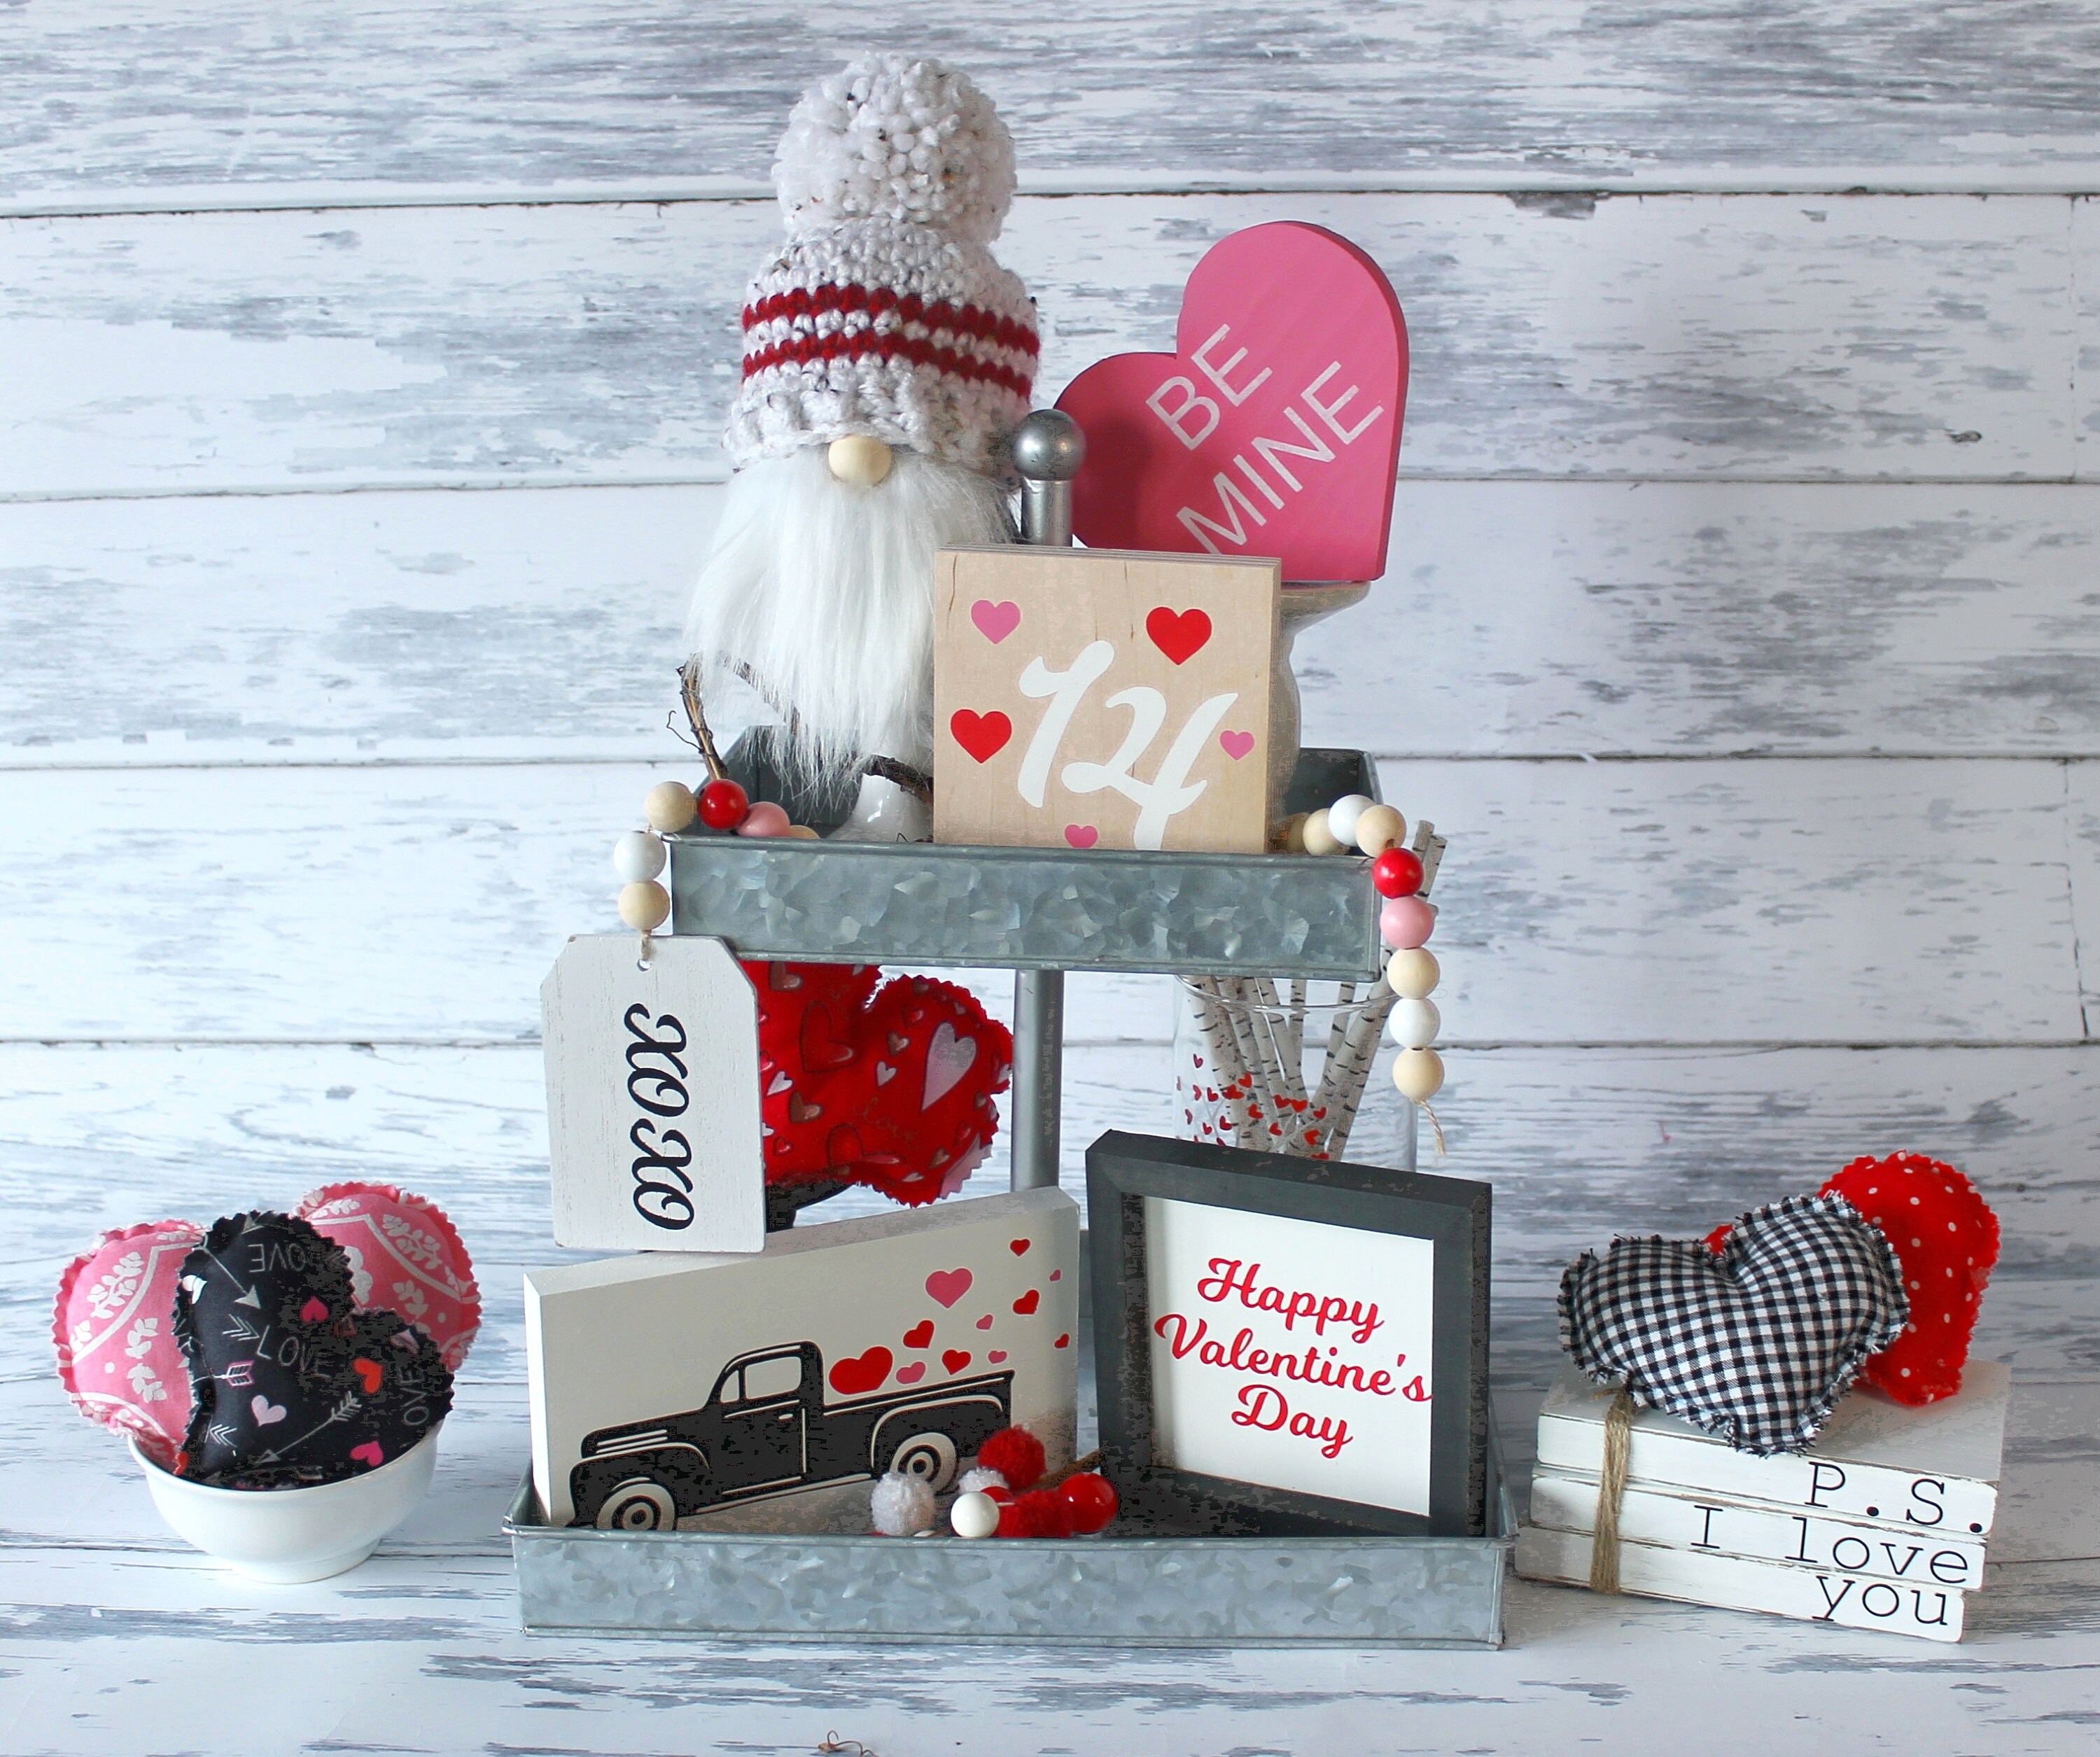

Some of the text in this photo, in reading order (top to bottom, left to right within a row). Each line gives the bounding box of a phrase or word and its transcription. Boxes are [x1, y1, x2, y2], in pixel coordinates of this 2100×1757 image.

[1145, 323, 1273, 451] BE
[1176, 360, 1384, 554] MINE
[1017, 640, 1239, 850] 14
[247, 1242, 307, 1273] OVE
[1198, 1257, 1385, 1343] Happy
[1154, 1314, 1434, 1402] Valentine's
[1231, 1384, 1353, 1459] Day
[1804, 1461, 1984, 1534] P.S.
[1690, 1505, 1968, 1584] I love
[1812, 1576, 1948, 1627] you
